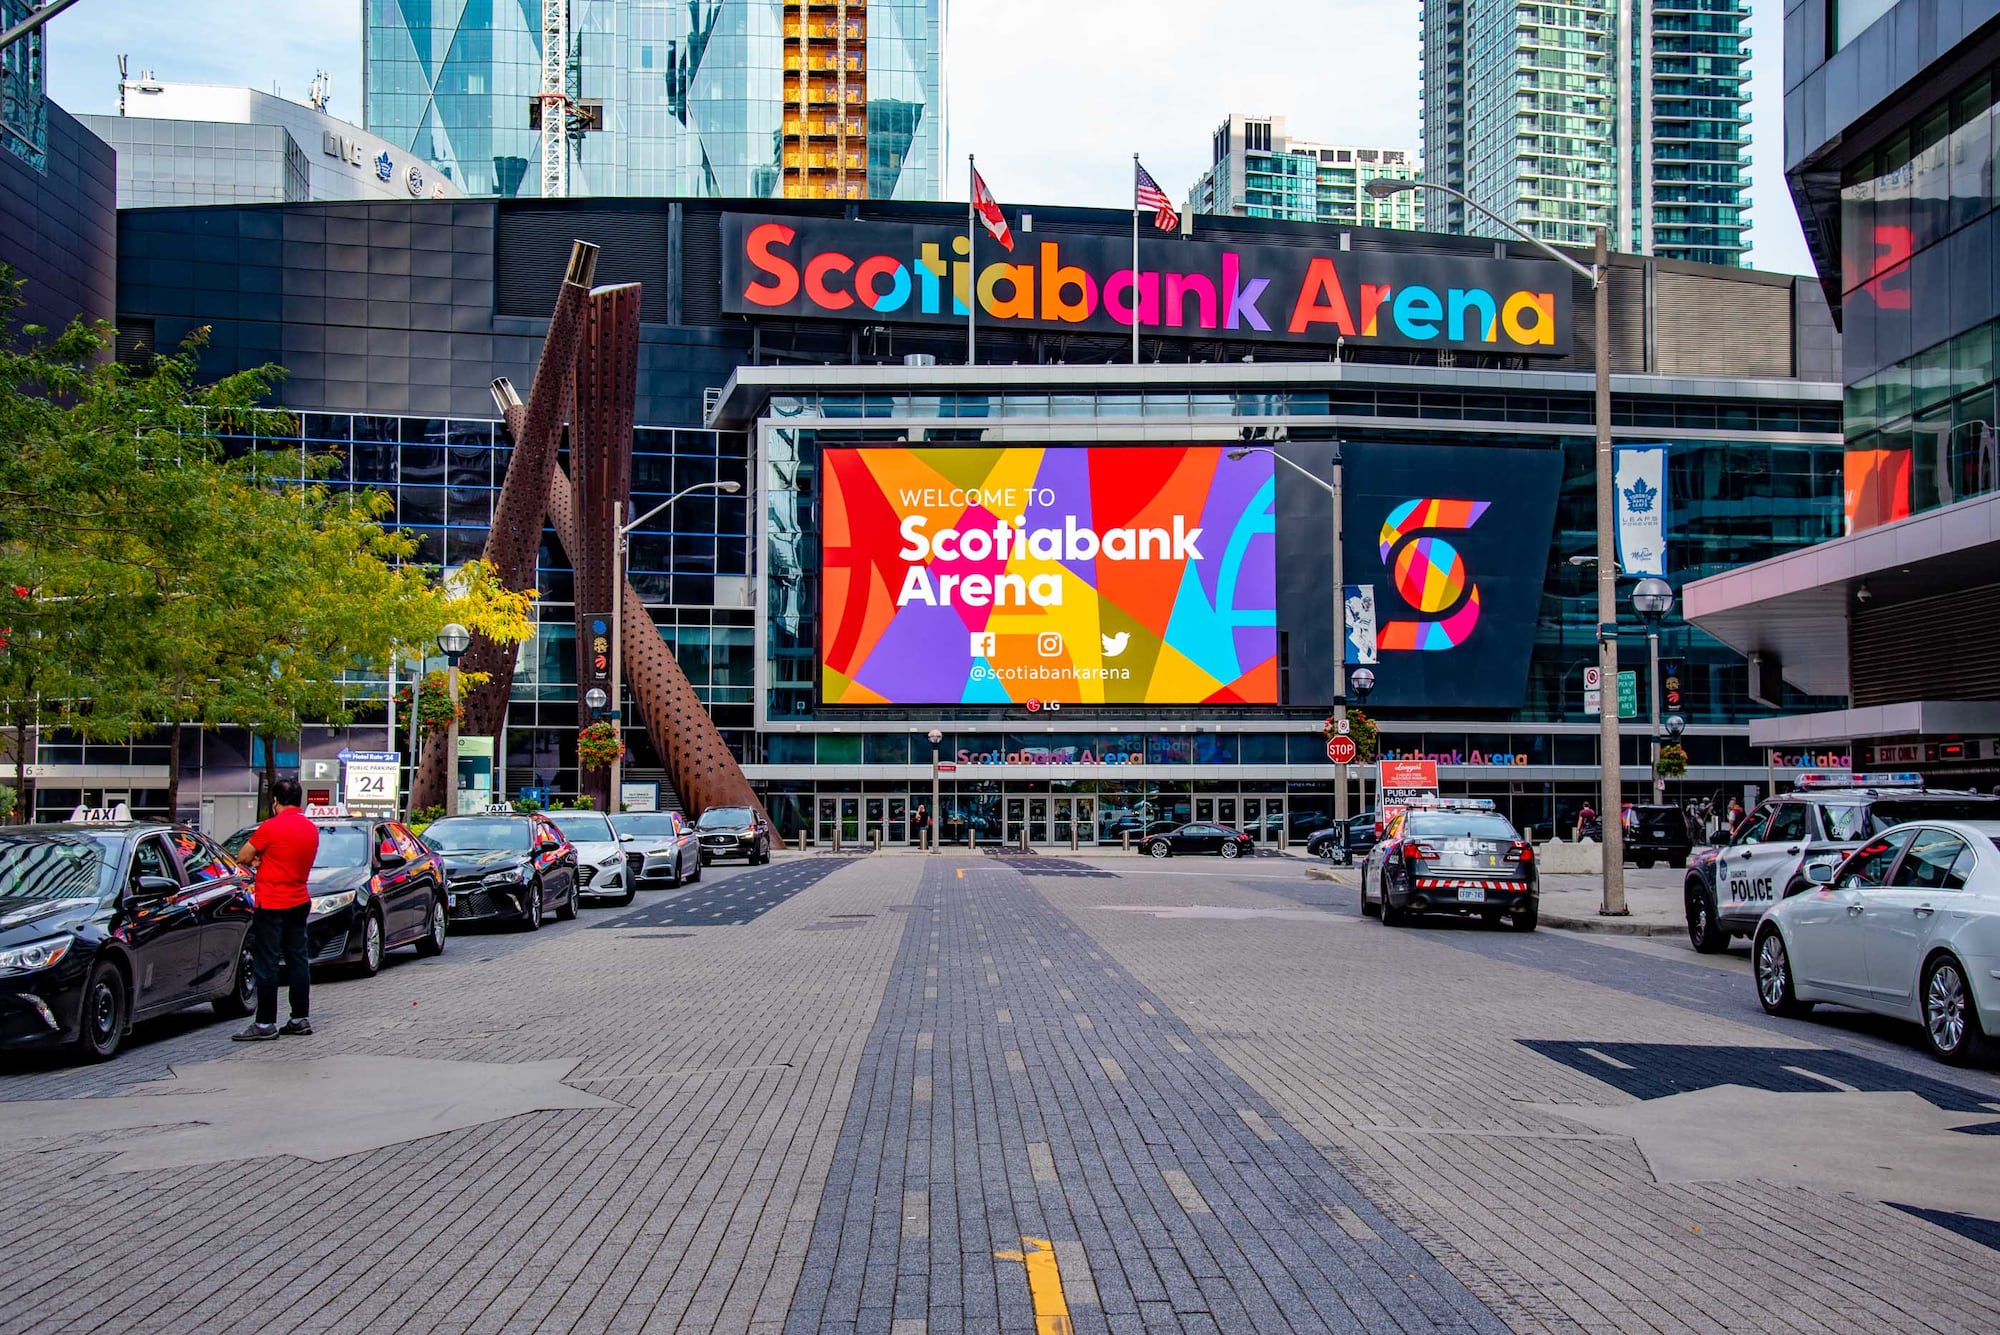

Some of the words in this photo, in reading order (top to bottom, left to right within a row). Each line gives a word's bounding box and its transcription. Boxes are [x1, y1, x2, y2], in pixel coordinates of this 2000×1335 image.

[744, 223, 1273, 332] Scotiabank
[1287, 256, 1555, 346] Arena
[899, 488, 1016, 507] WELCOME
[1024, 488, 1056, 507] TO
[899, 515, 1204, 562] Scotiabank
[896, 565, 1063, 607] Arena
[970, 665, 1130, 682] @scotiabankarena
[1043, 700, 1060, 711] LG
[957, 749, 1073, 765] Scotiabank
[1080, 749, 1143, 765] Arena
[1329, 744, 1353, 756] STOP
[1470, 749, 1528, 766] Arena
[1880, 748, 1896, 762] EXIT
[1898, 746, 1918, 761] ONLY
[26, 766, 33, 776] 6
[315, 762, 327, 778] P
[1387, 789, 1416, 797] PUBLIC
[82, 808, 117, 821] TAXI
[310, 807, 339, 816] TAXI
[484, 804, 508, 813] TAXI
[1444, 841, 1497, 851] POLICE
[1730, 870, 1747, 878] TORONTO
[1730, 877, 1773, 902] POLICE
